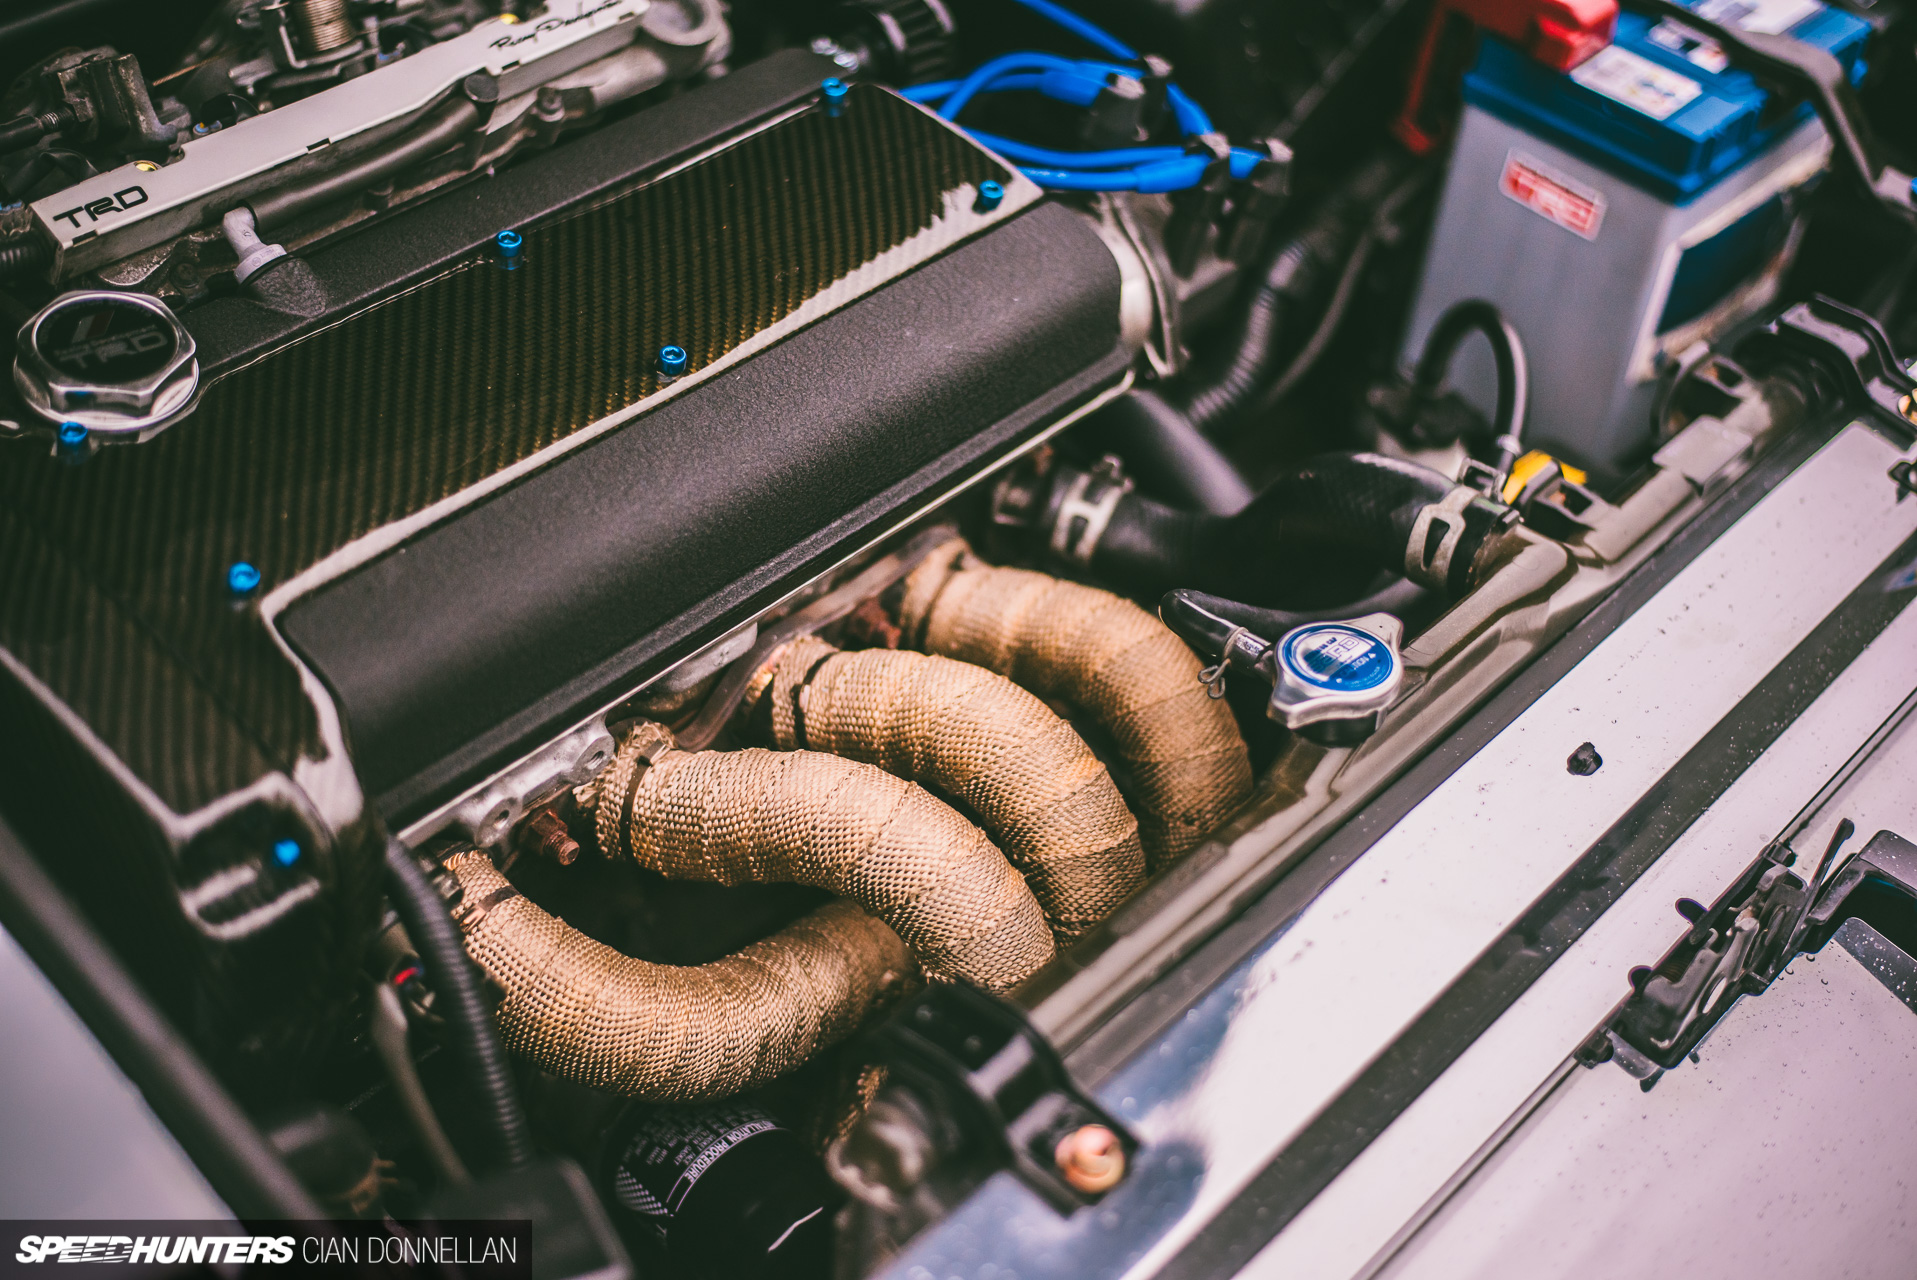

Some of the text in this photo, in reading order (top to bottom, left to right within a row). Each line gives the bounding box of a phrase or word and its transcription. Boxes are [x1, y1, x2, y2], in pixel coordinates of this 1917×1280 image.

[53, 185, 149, 228] TRD
[59, 331, 168, 369] TRD
[672, 1144, 691, 1165] GASKET
[682, 1151, 696, 1164] FACE
[684, 1138, 728, 1182] PROCEDURE
